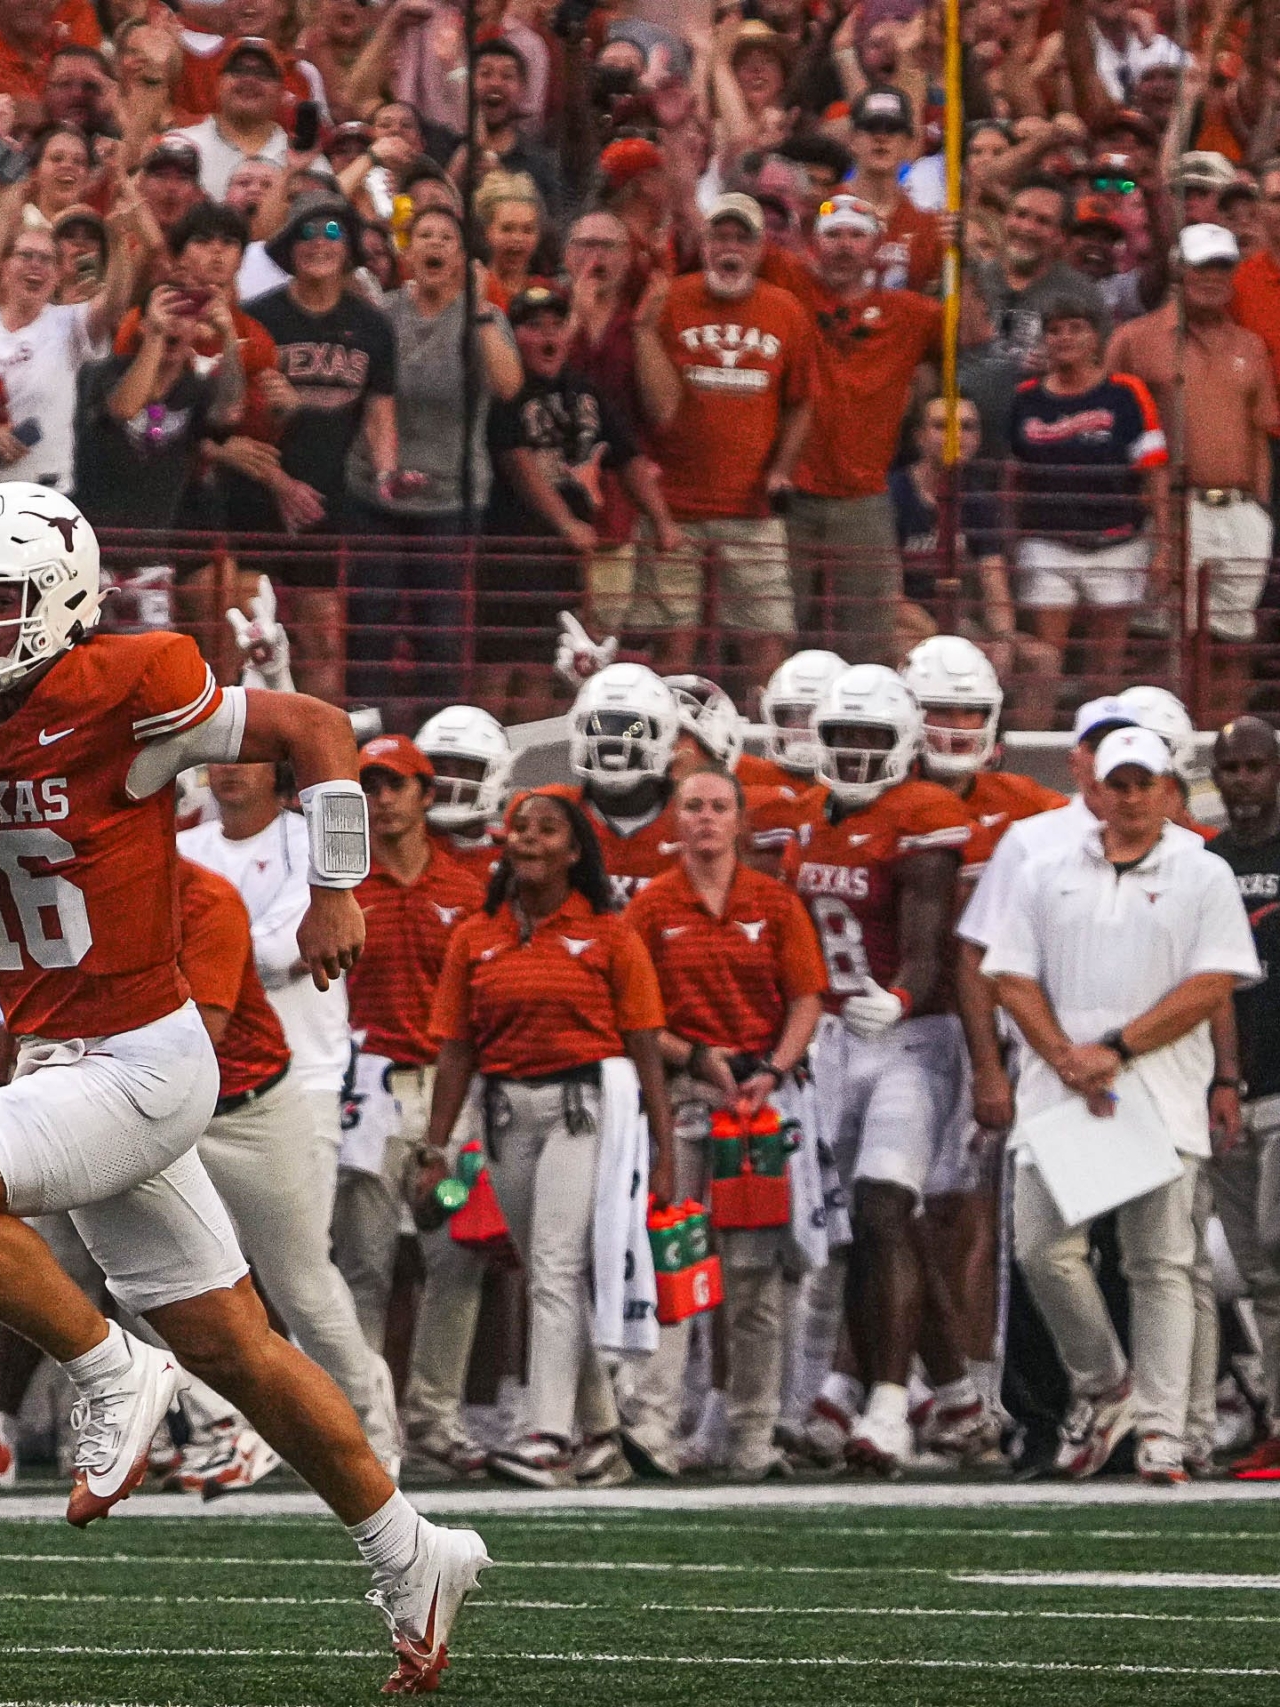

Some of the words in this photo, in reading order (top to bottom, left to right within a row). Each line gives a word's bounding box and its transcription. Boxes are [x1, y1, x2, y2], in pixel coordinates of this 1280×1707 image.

[679, 324, 781, 360] TEXAS
[797, 862, 869, 898] TEXAS
[1235, 872, 1280, 898] XAS
[813, 896, 871, 994] 8
